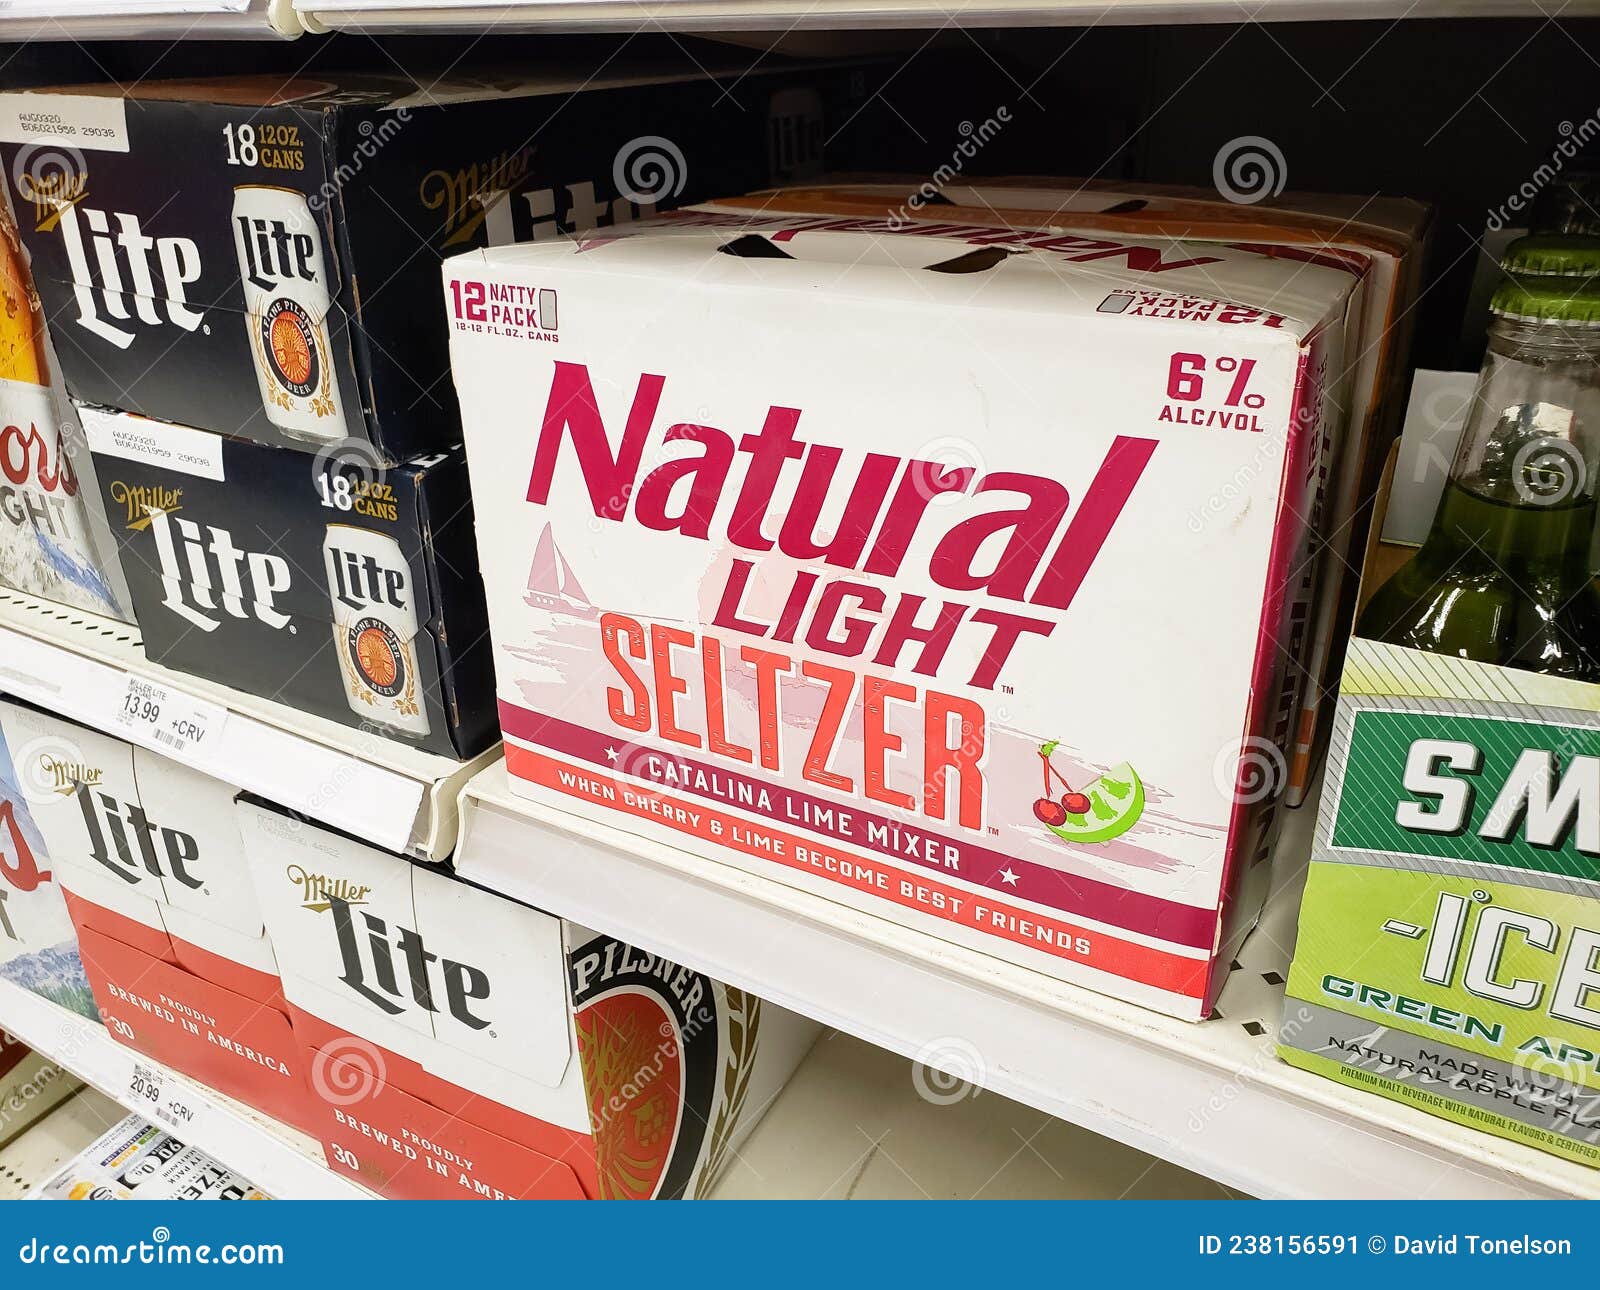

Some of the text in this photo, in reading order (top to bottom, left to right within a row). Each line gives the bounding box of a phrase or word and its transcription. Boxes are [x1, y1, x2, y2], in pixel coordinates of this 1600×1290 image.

[223, 122, 258, 166] 18
[260, 148, 304, 171] CANS
[19, 171, 88, 224] Miller
[420, 146, 537, 236] Miller
[47, 198, 204, 349] Lite
[237, 216, 315, 292] Lite
[450, 280, 487, 322] 12
[490, 283, 536, 305] NATTY
[1128, 306, 1212, 322] NATTY
[1136, 296, 1218, 312] PACK
[456, 322, 482, 332] 12-12
[528, 331, 559, 342] CANS
[491, 304, 538, 328] PACK
[287, 381, 311, 394] BEER
[1166, 352, 1266, 409] 6%
[1158, 405, 1264, 432] ALC/VOL
[111, 481, 183, 521] Miller
[318, 472, 351, 511] 18
[525, 359, 1160, 611] Natural
[354, 499, 398, 521] CANS
[140, 504, 292, 632] Lite
[329, 547, 405, 611] Lite
[711, 557, 1056, 691] LIGHT
[124, 693, 160, 723] 13.99
[372, 683, 395, 695] BEER
[172, 720, 205, 742] +CRV
[599, 612, 987, 835] SELTZER
[40, 754, 104, 786] Miller
[66, 776, 204, 890] Lite
[649, 756, 961, 871] CATALINA LIME MIXER
[287, 864, 371, 901] Miller
[558, 769, 1091, 956] WHEN CHERRY & LIME BECOME BEST FRIENDS
[320, 890, 492, 1031] Lite
[107, 983, 175, 1024] BREWED
[181, 1017, 200, 1037] IN
[207, 1030, 292, 1078] AMERICA
[112, 1016, 136, 1040] 30
[160, 994, 216, 1028] PROUDLY
[1322, 975, 1600, 1075] GREEN AP
[130, 1075, 160, 1102] 20.99
[1328, 1036, 1450, 1084] NATURAL
[1456, 1078, 1550, 1115] APPLE
[1418, 1049, 1575, 1106] MADE WITH
[169, 1102, 194, 1122] +CRV
[1340, 1066, 1379, 1086] PREMIUM
[1379, 1076, 1401, 1094] MALT
[1402, 1081, 1445, 1109] BEVERAGE
[1444, 1098, 1467, 1115] WITH
[1467, 1106, 1507, 1130] NATURAL
[1508, 1121, 1546, 1142] FLAVORS
[1547, 1134, 1554, 1144] &
[331, 1143, 359, 1171] 30
[334, 1108, 417, 1161] BREWED
[426, 1156, 449, 1177] IN
[401, 1128, 473, 1171] PROUDLY
